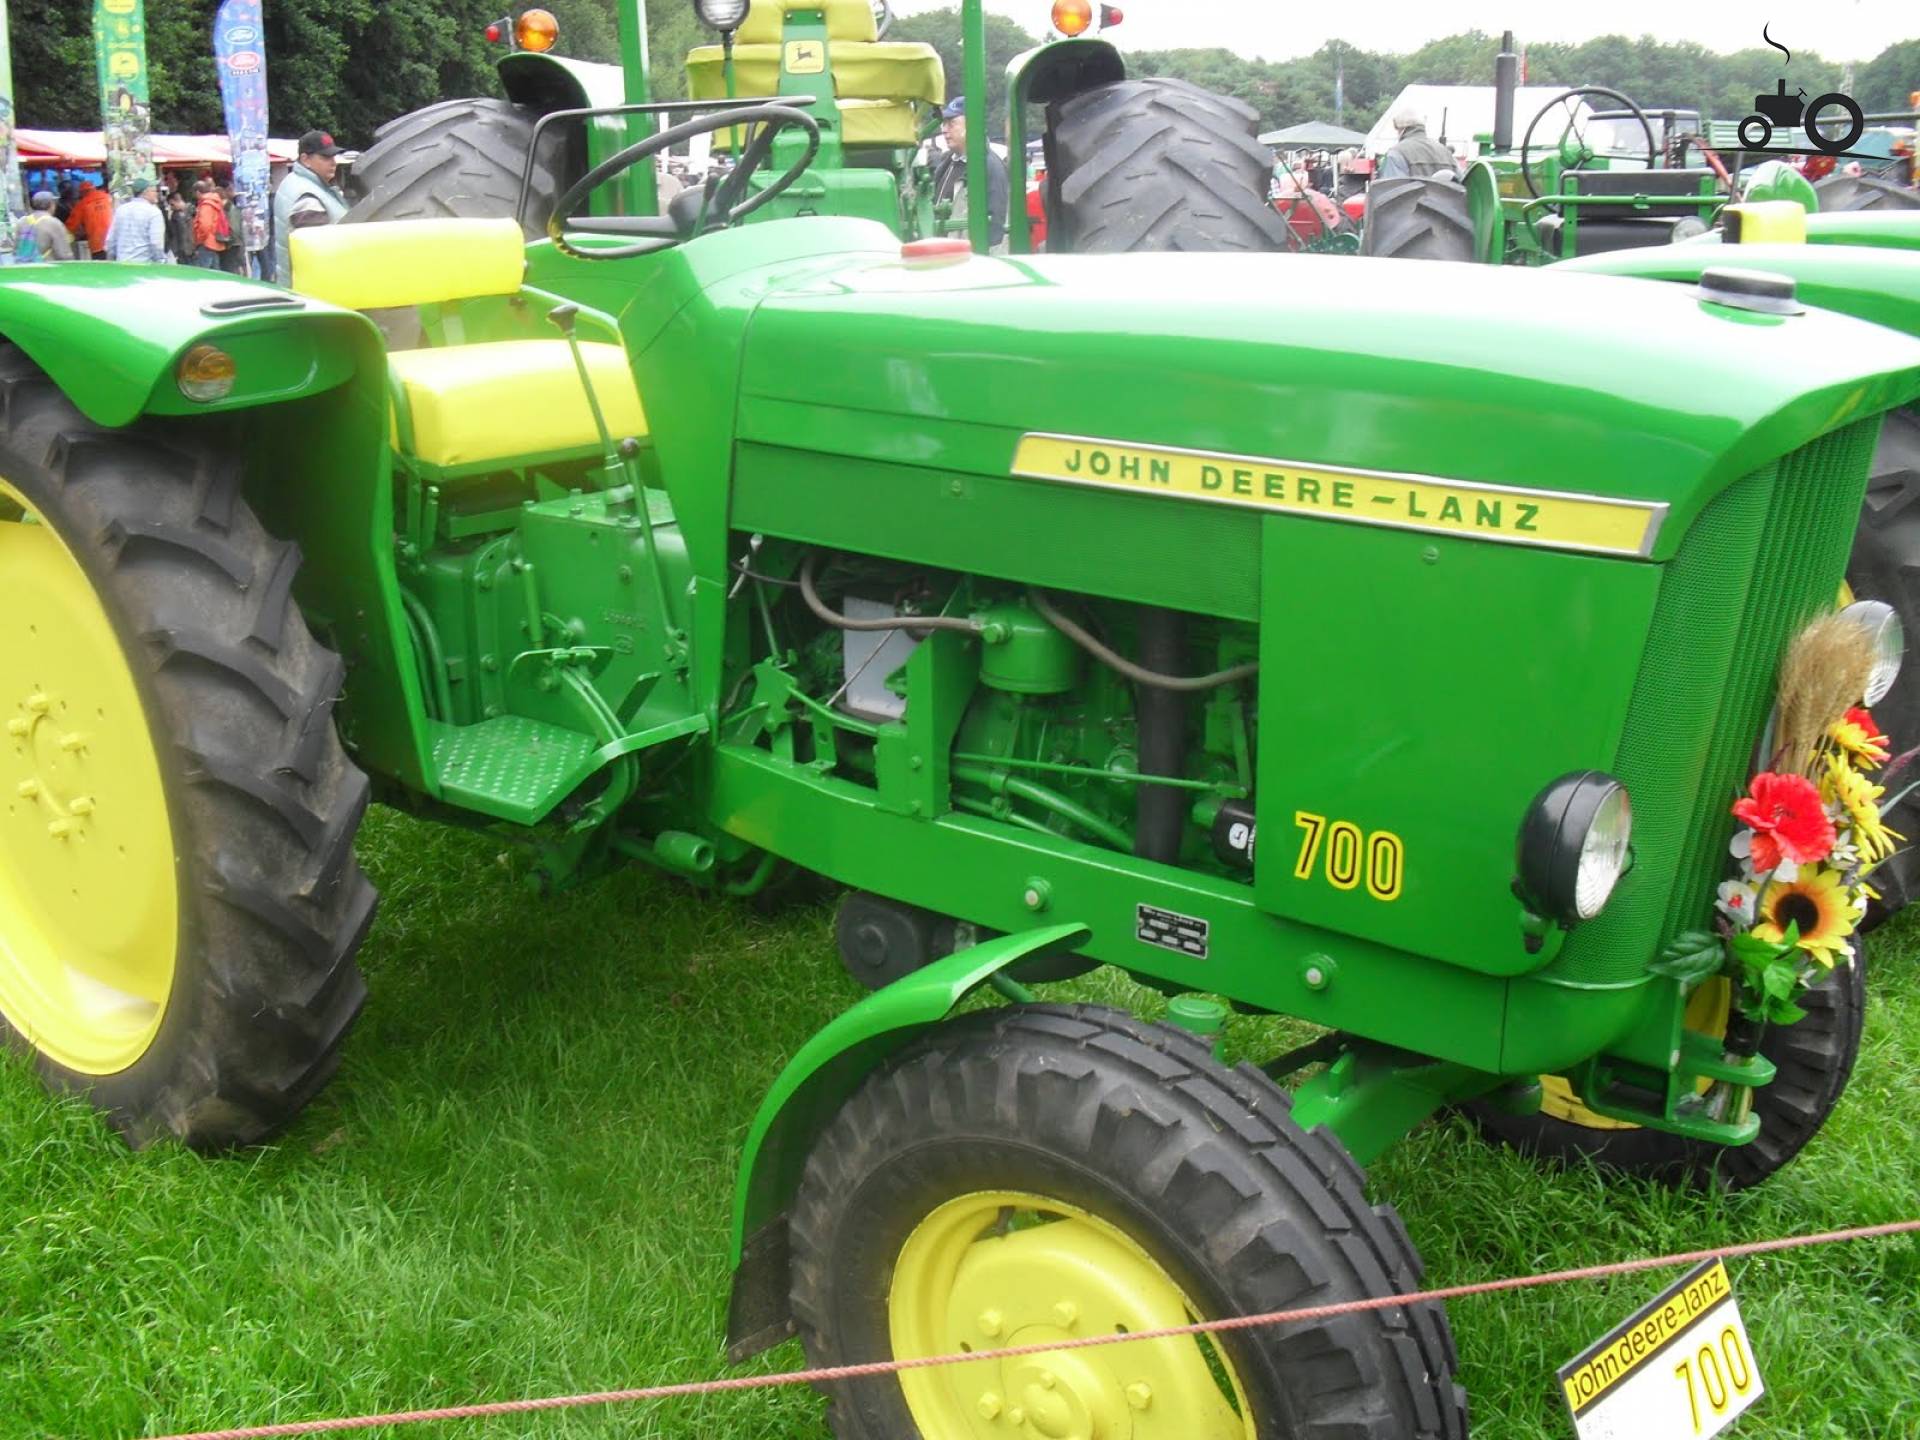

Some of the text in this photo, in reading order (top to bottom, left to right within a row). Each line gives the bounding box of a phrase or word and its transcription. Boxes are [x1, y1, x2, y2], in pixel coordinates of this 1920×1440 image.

[1065, 449, 1170, 483] JOHN
[1294, 810, 1404, 901] 700
[1571, 1352, 1621, 1405] john
[1673, 1326, 1750, 1434] 700
